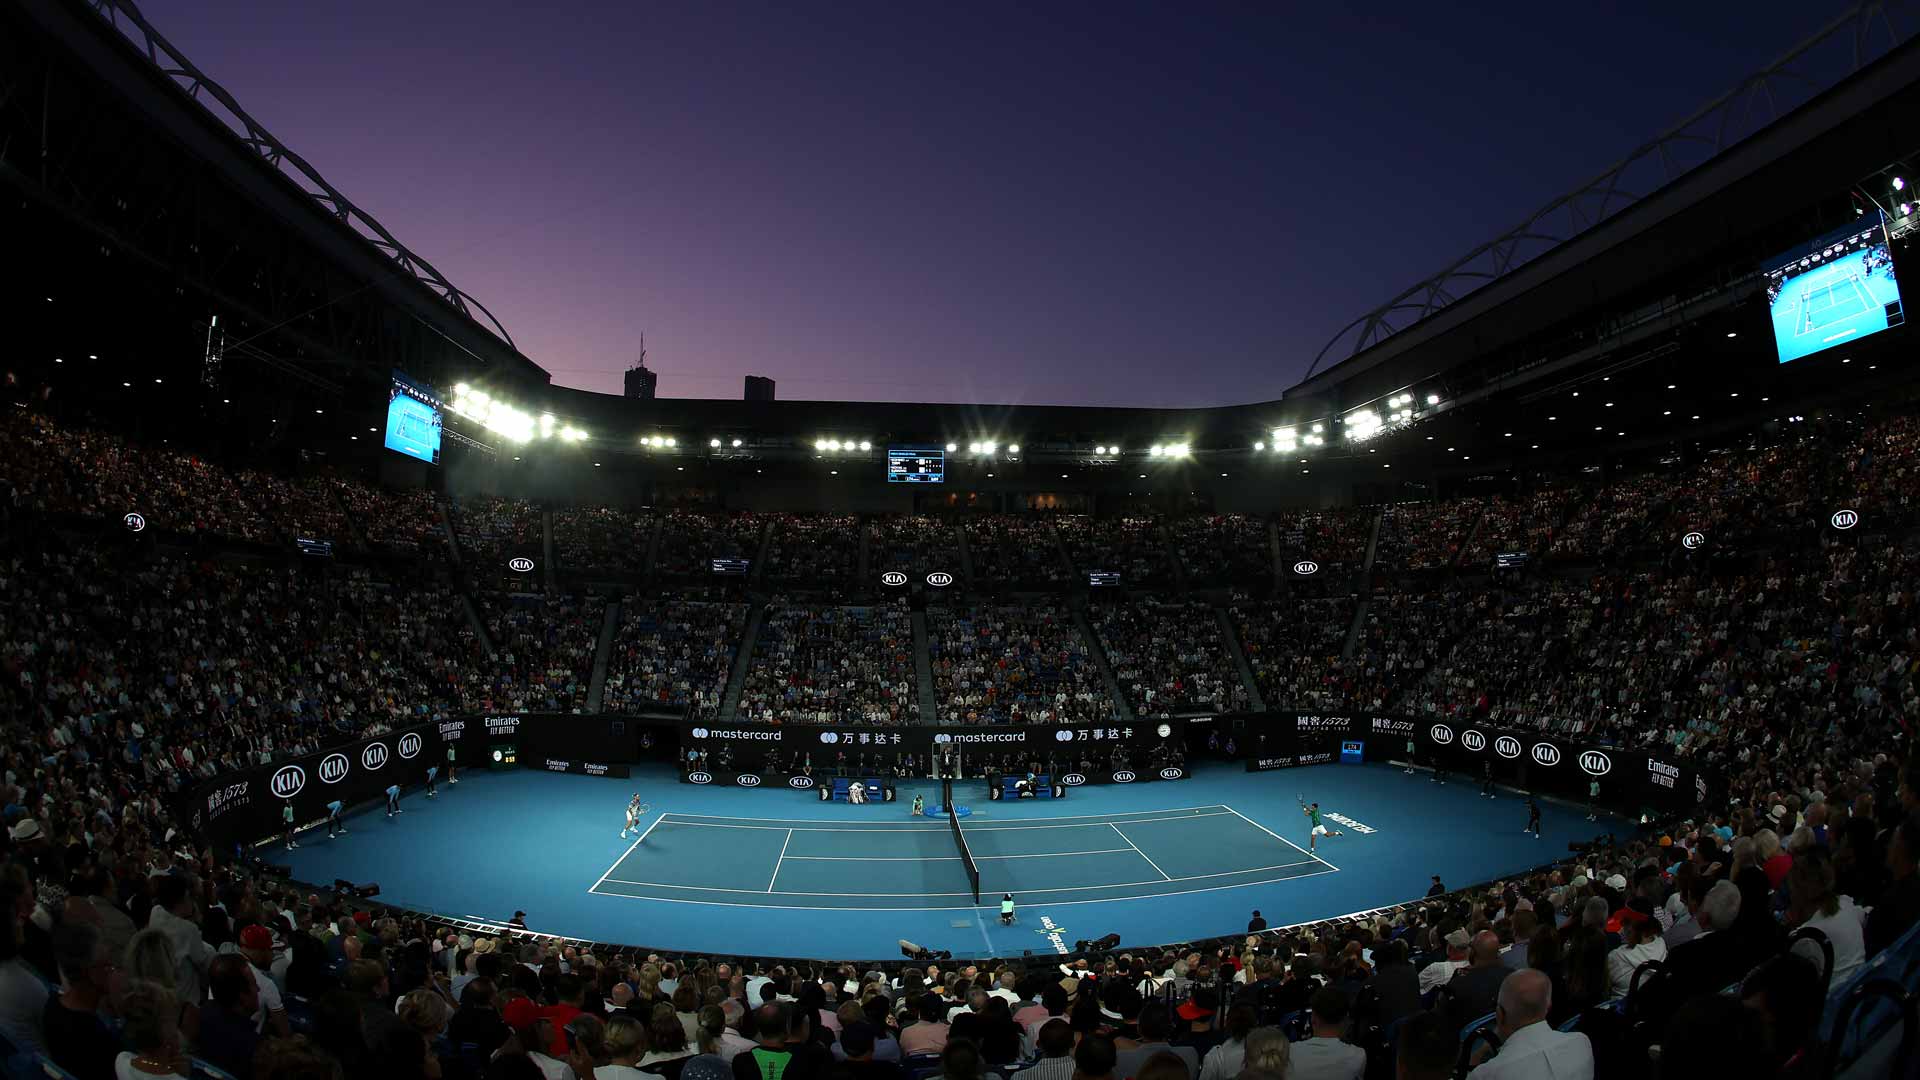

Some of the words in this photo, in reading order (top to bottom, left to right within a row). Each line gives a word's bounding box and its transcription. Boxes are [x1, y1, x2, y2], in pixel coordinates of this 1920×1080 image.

[439, 720, 464, 734] Emirates
[485, 716, 520, 727] Emirates
[711, 730, 782, 740] mastercard
[842, 732, 902, 744] 万事达卡
[954, 731, 1026, 744] mastercard
[1078, 727, 1133, 740] 万事达卡
[546, 759, 570, 767] Emirates
[584, 762, 608, 770] Emirates
[1648, 758, 1680, 778] Emirates
